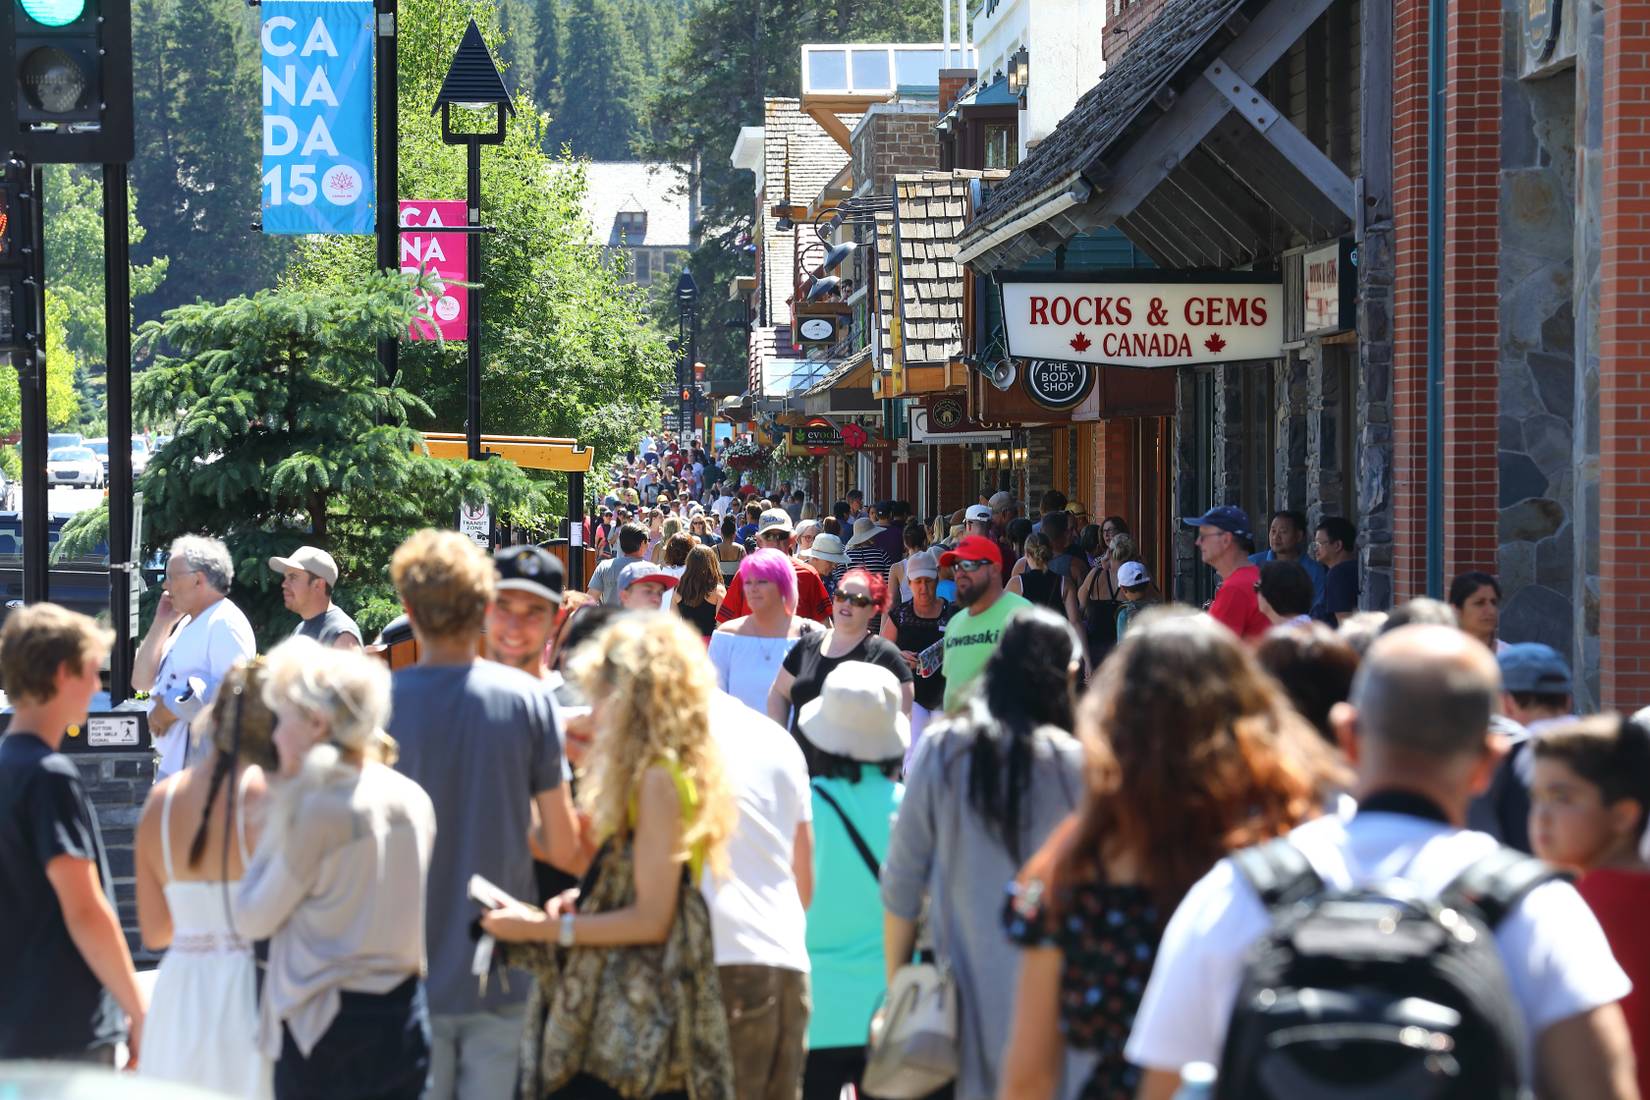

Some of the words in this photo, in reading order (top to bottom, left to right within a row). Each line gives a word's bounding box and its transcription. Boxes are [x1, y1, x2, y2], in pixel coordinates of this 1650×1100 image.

[261, 15, 339, 57] CA
[262, 64, 340, 107] NA
[263, 114, 340, 156] DA
[400, 207, 445, 228] CA
[401, 236, 447, 262] NA
[1029, 296, 1132, 326] ROCKS
[1147, 297, 1168, 326] &
[1184, 297, 1267, 326] GEMS
[1103, 332, 1193, 357] CANADA
[1041, 372, 1076, 382] BODY
[1047, 363, 1068, 372] THE
[1043, 382, 1075, 392] SHOP
